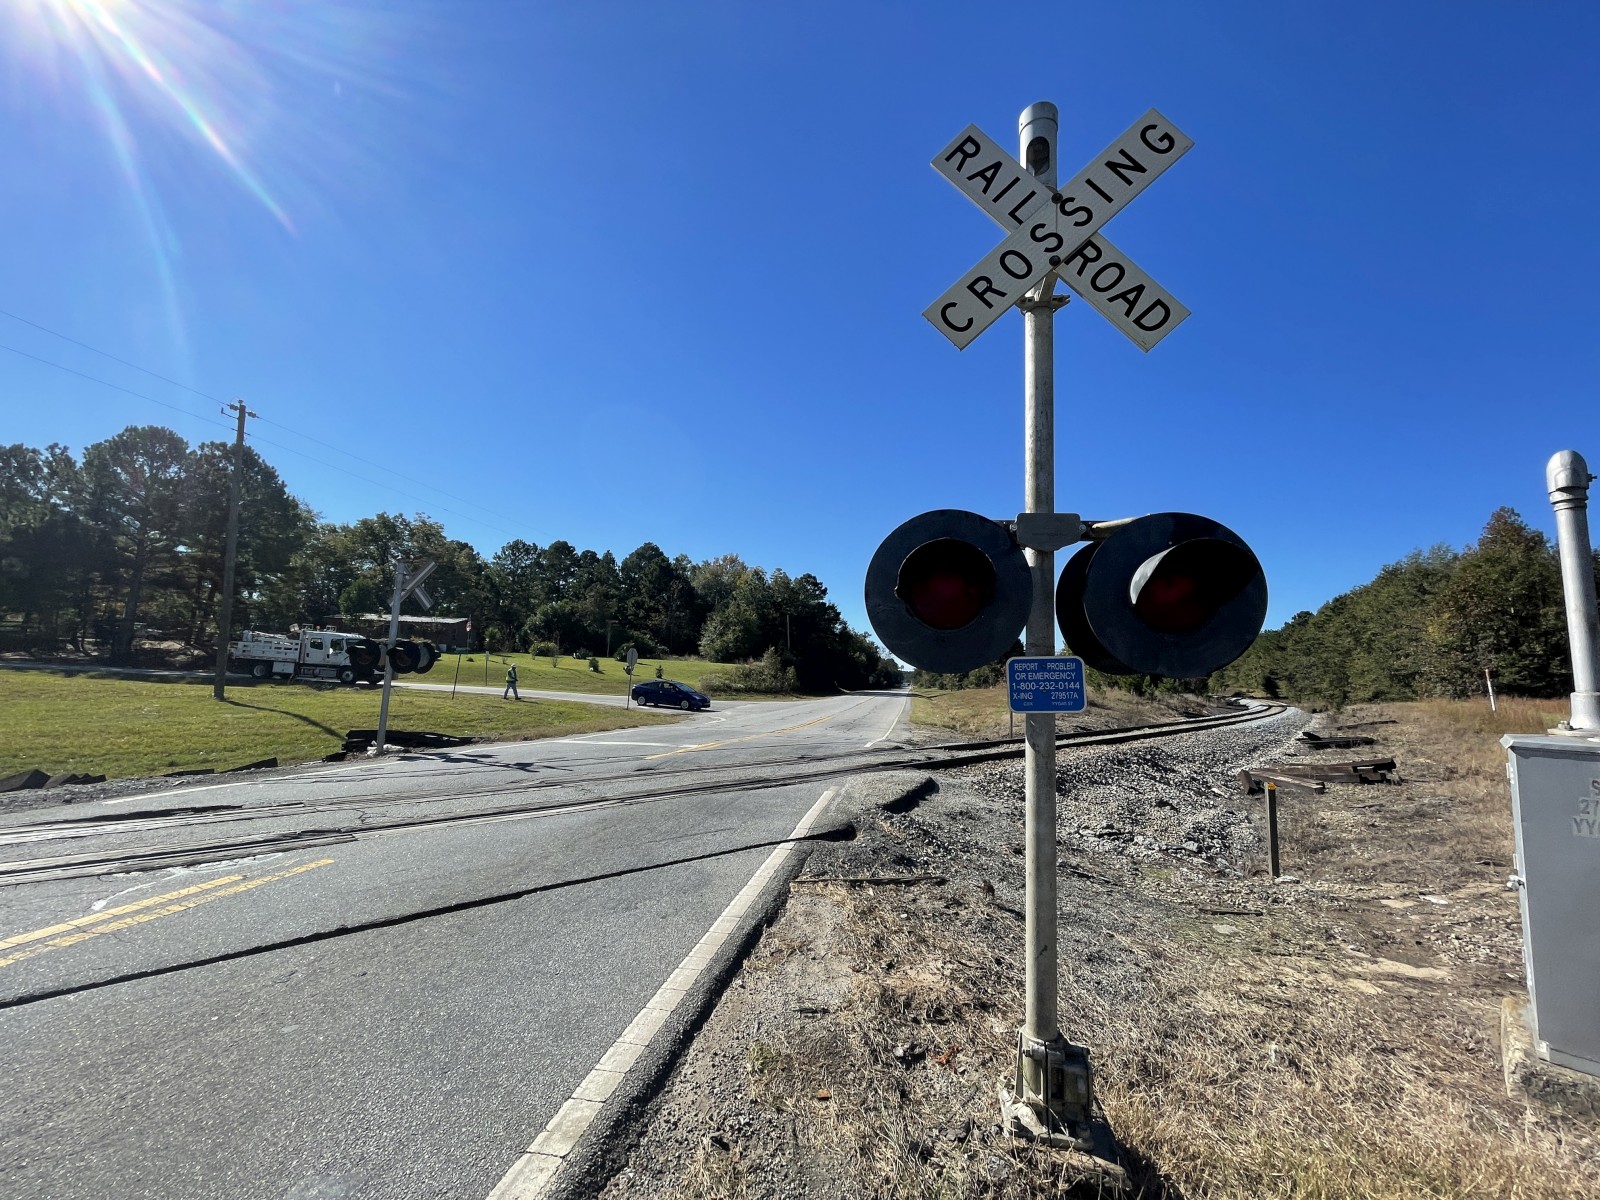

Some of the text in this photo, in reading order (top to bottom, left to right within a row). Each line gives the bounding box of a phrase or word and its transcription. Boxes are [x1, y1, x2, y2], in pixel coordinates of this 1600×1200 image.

[940, 123, 1176, 333] CROSSING
[945, 135, 1171, 332] RAIL ROAD
[1015, 671, 1076, 680] OR EMERGENCY
[1012, 681, 1080, 690] 1-800-232-0144
[1573, 817, 1600, 835] YY
